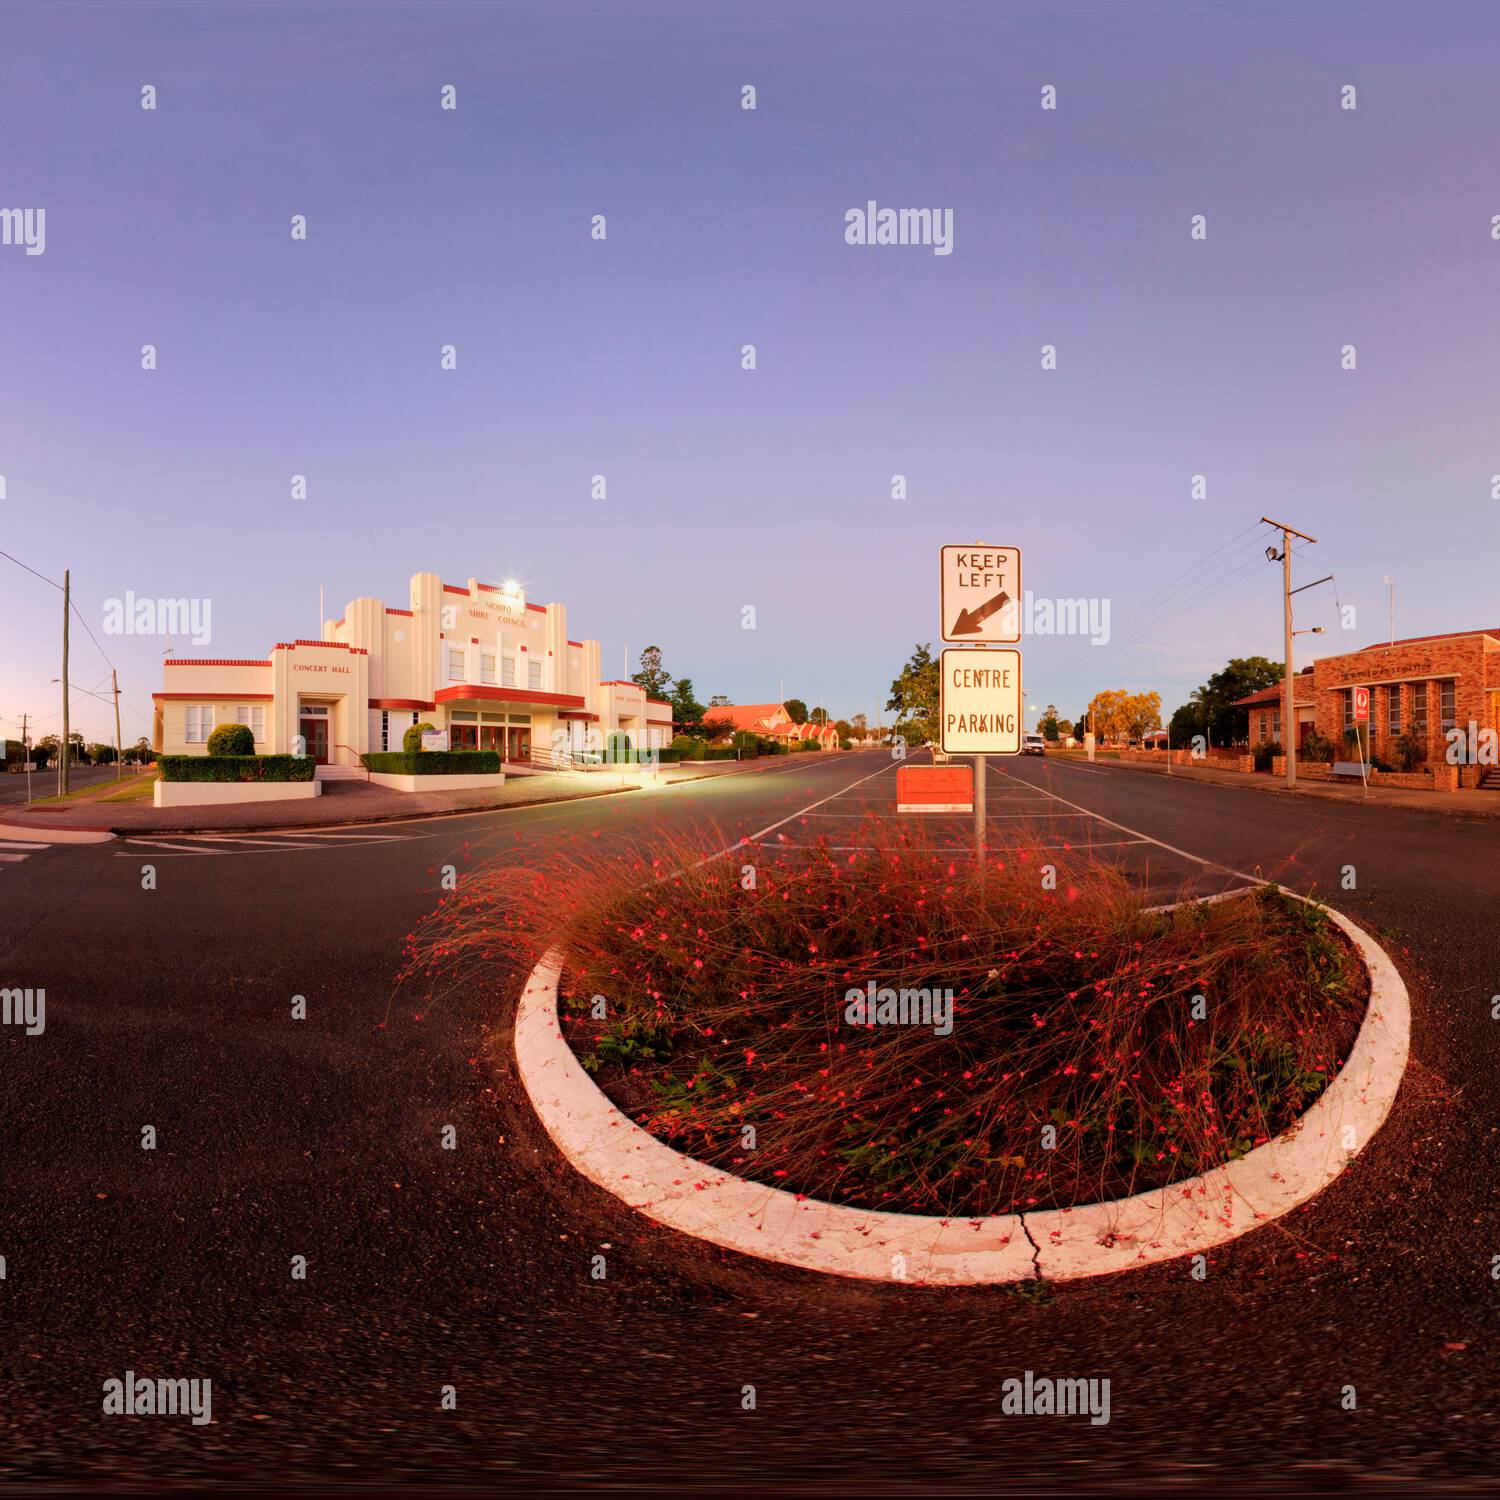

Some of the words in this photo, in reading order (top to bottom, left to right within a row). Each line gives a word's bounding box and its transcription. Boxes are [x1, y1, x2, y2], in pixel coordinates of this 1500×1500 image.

[957, 554, 1007, 568] KEEP
[959, 573, 1005, 588] LEFT
[293, 664, 327, 672] CONCERT
[332, 666, 351, 674] HALL
[953, 669, 1010, 688] CENTRE
[947, 713, 1015, 733] PARKING
